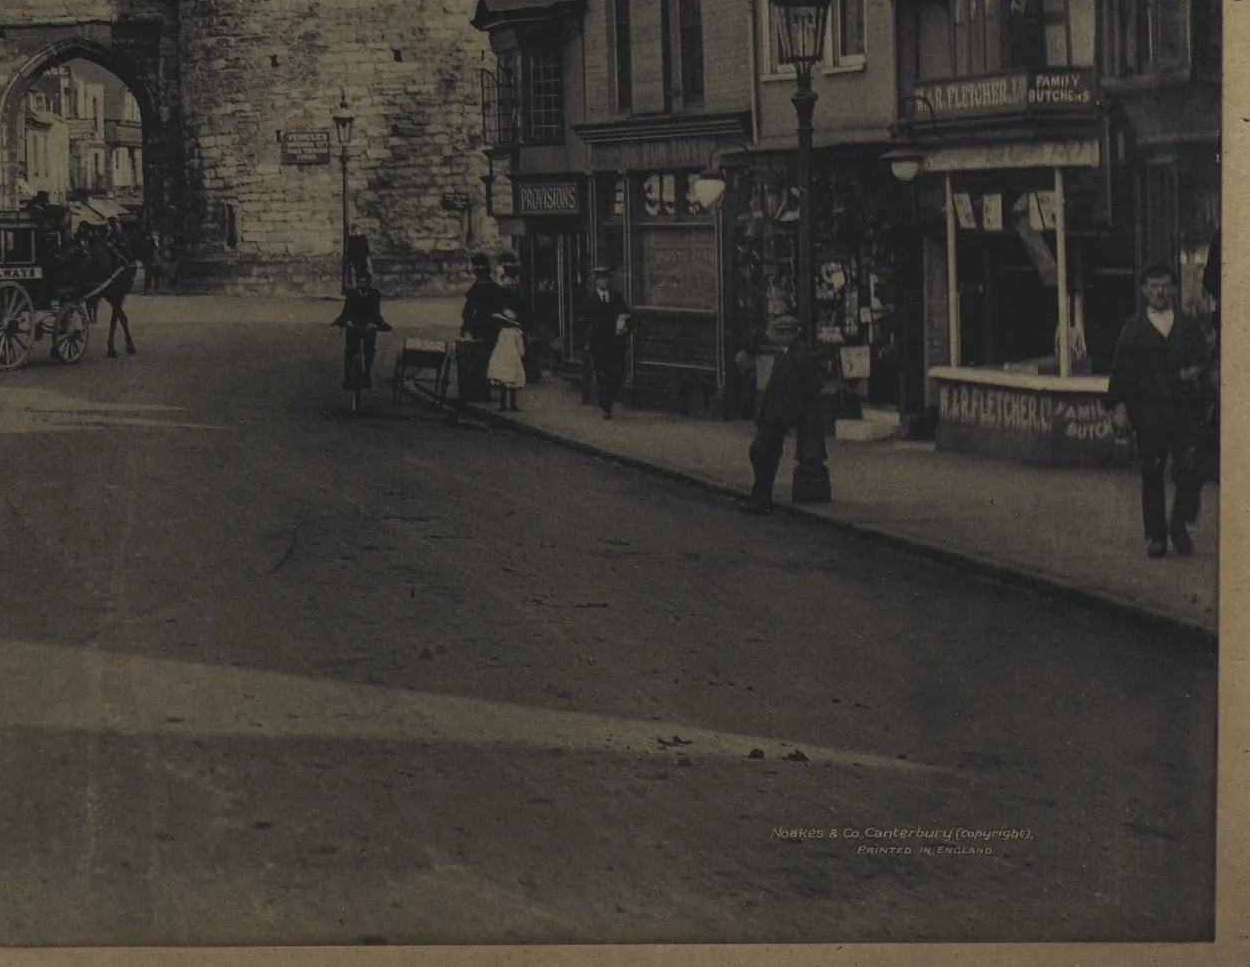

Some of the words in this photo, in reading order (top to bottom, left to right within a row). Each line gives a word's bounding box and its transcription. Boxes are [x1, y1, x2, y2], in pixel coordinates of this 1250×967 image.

[1036, 74, 1081, 87] FAMILY
[1028, 88, 1090, 104] BUTCHERS
[520, 187, 576, 210] PROVISIONS
[1053, 399, 1103, 419] FAMIL
